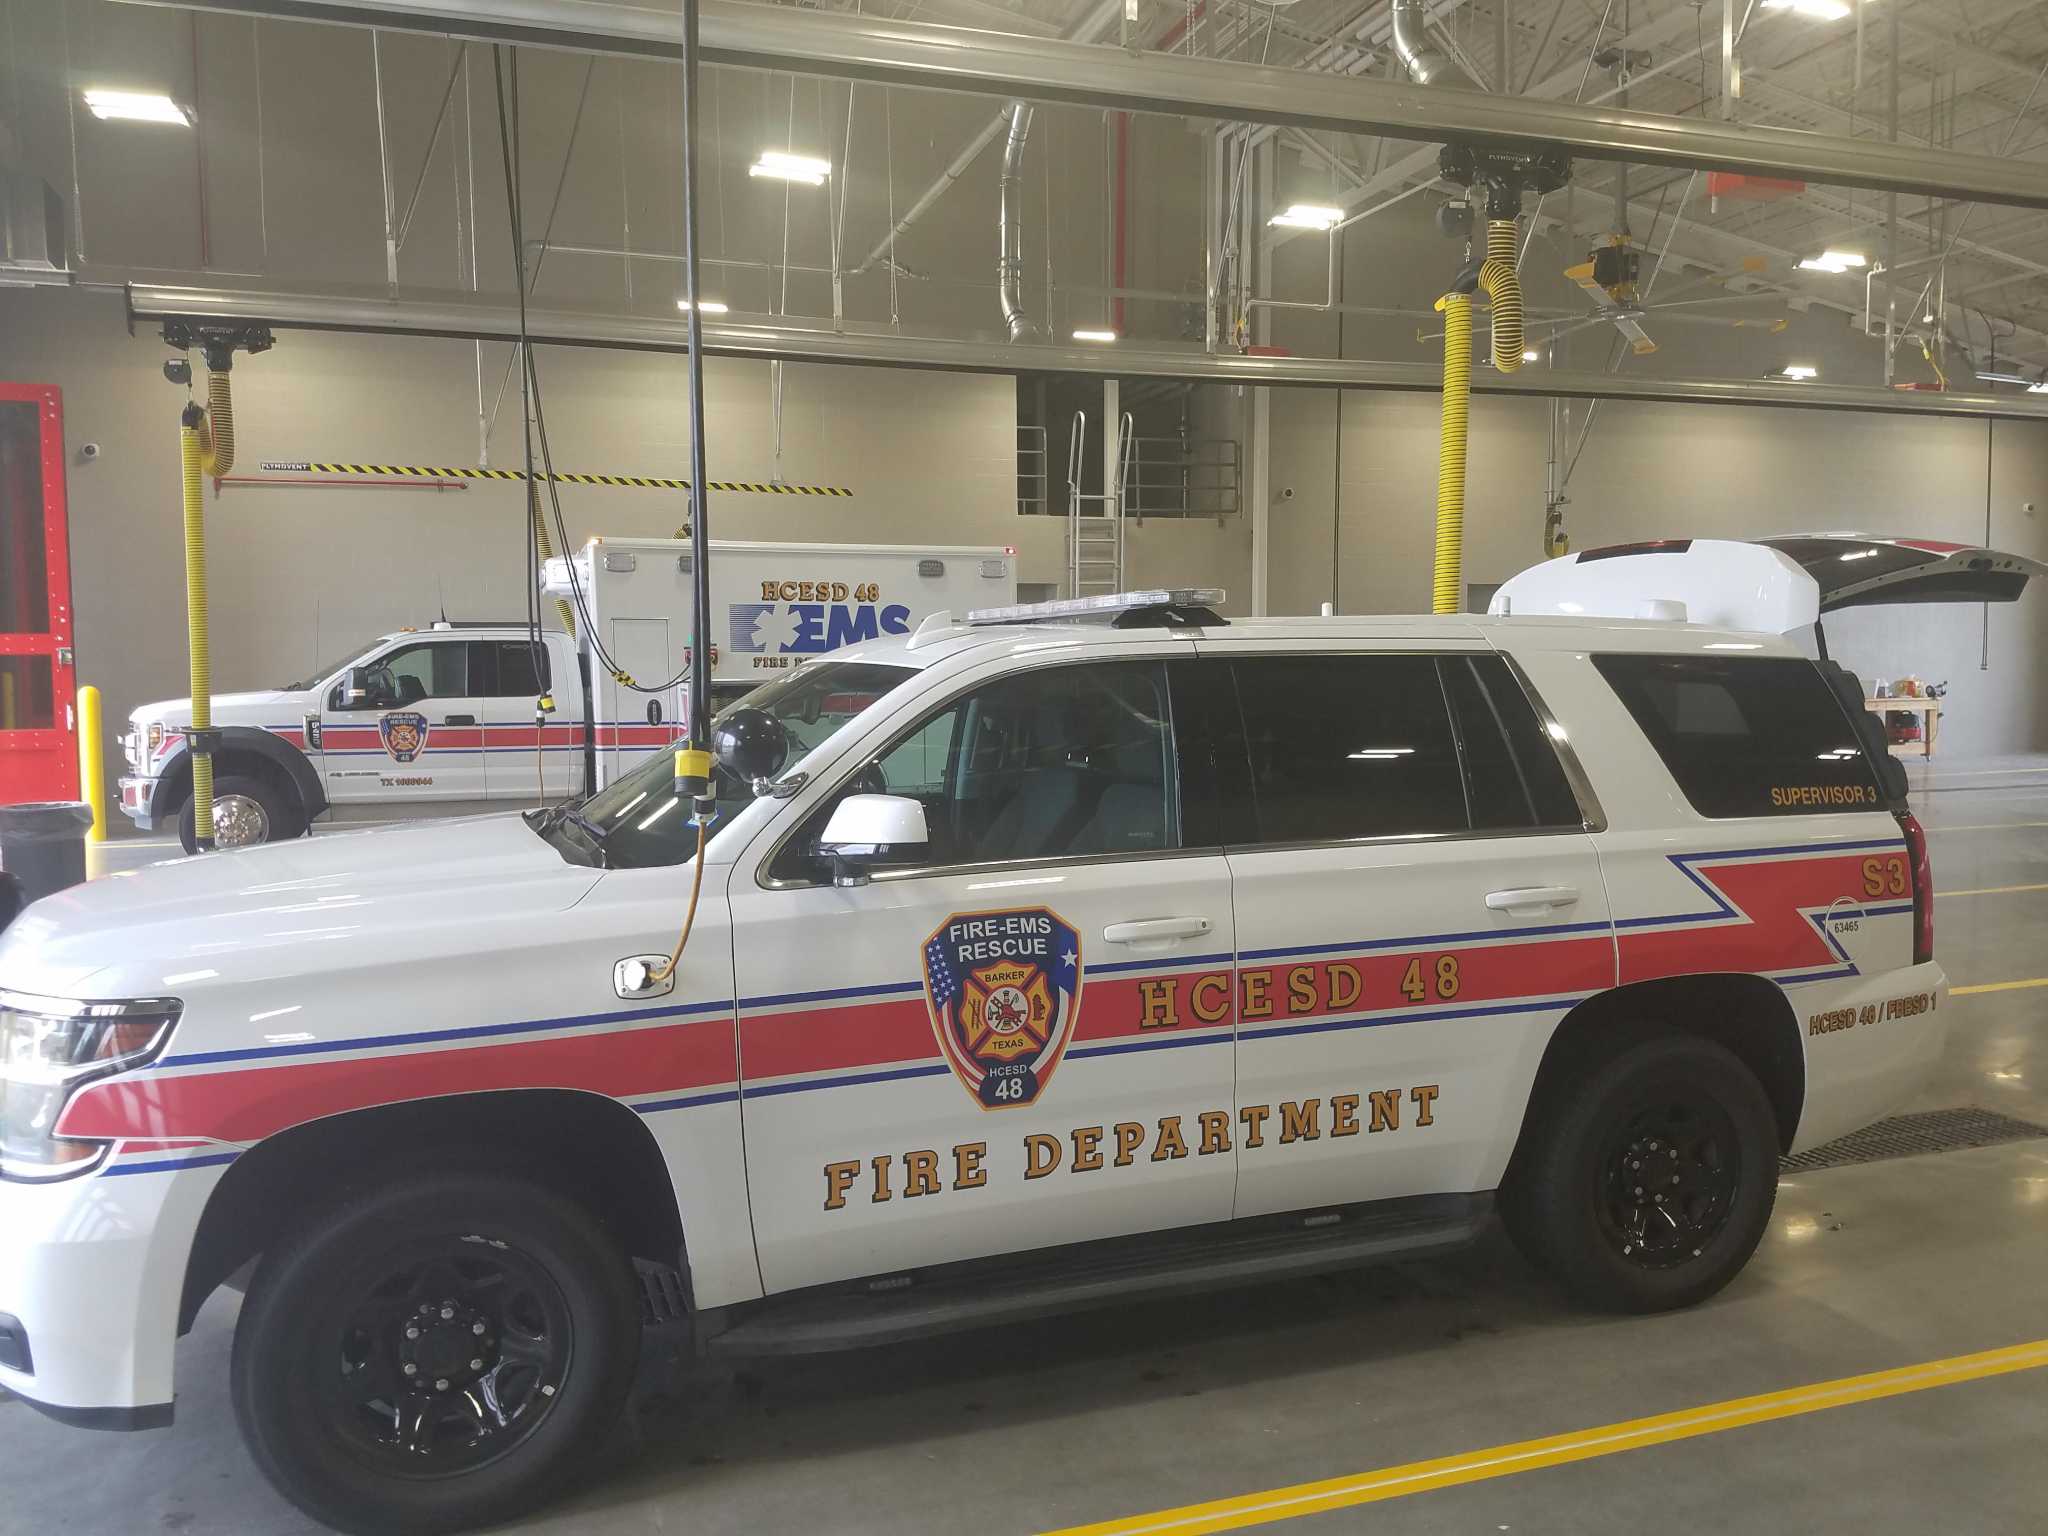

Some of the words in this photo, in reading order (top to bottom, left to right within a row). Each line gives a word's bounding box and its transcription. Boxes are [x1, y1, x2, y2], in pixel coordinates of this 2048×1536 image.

[761, 581, 849, 601] HCESD
[854, 583, 880, 602] 48
[779, 604, 911, 652] EMS
[753, 656, 789, 668] FIRE
[1771, 786, 1865, 806] SUPERVISOR
[1867, 786, 1877, 802] 3
[1862, 857, 1906, 897] S3
[950, 917, 1051, 943] FIRE-EMS
[1834, 920, 1859, 934] 63465
[958, 938, 1049, 962] RESCUE
[984, 970, 1025, 983] BARKER
[1139, 964, 1362, 1029] HCESD
[1401, 954, 1461, 1001] 48
[1809, 1008, 1857, 1036] HCESD
[1859, 1004, 1876, 1025] 48
[1931, 991, 1937, 1010] 1
[992, 1039, 1024, 1050] TEXAS
[989, 1065, 1028, 1077] HCESD
[995, 1078, 1023, 1100] 48
[823, 1141, 987, 1210] FIRE
[1024, 1085, 1440, 1180] DEPARTMENT
